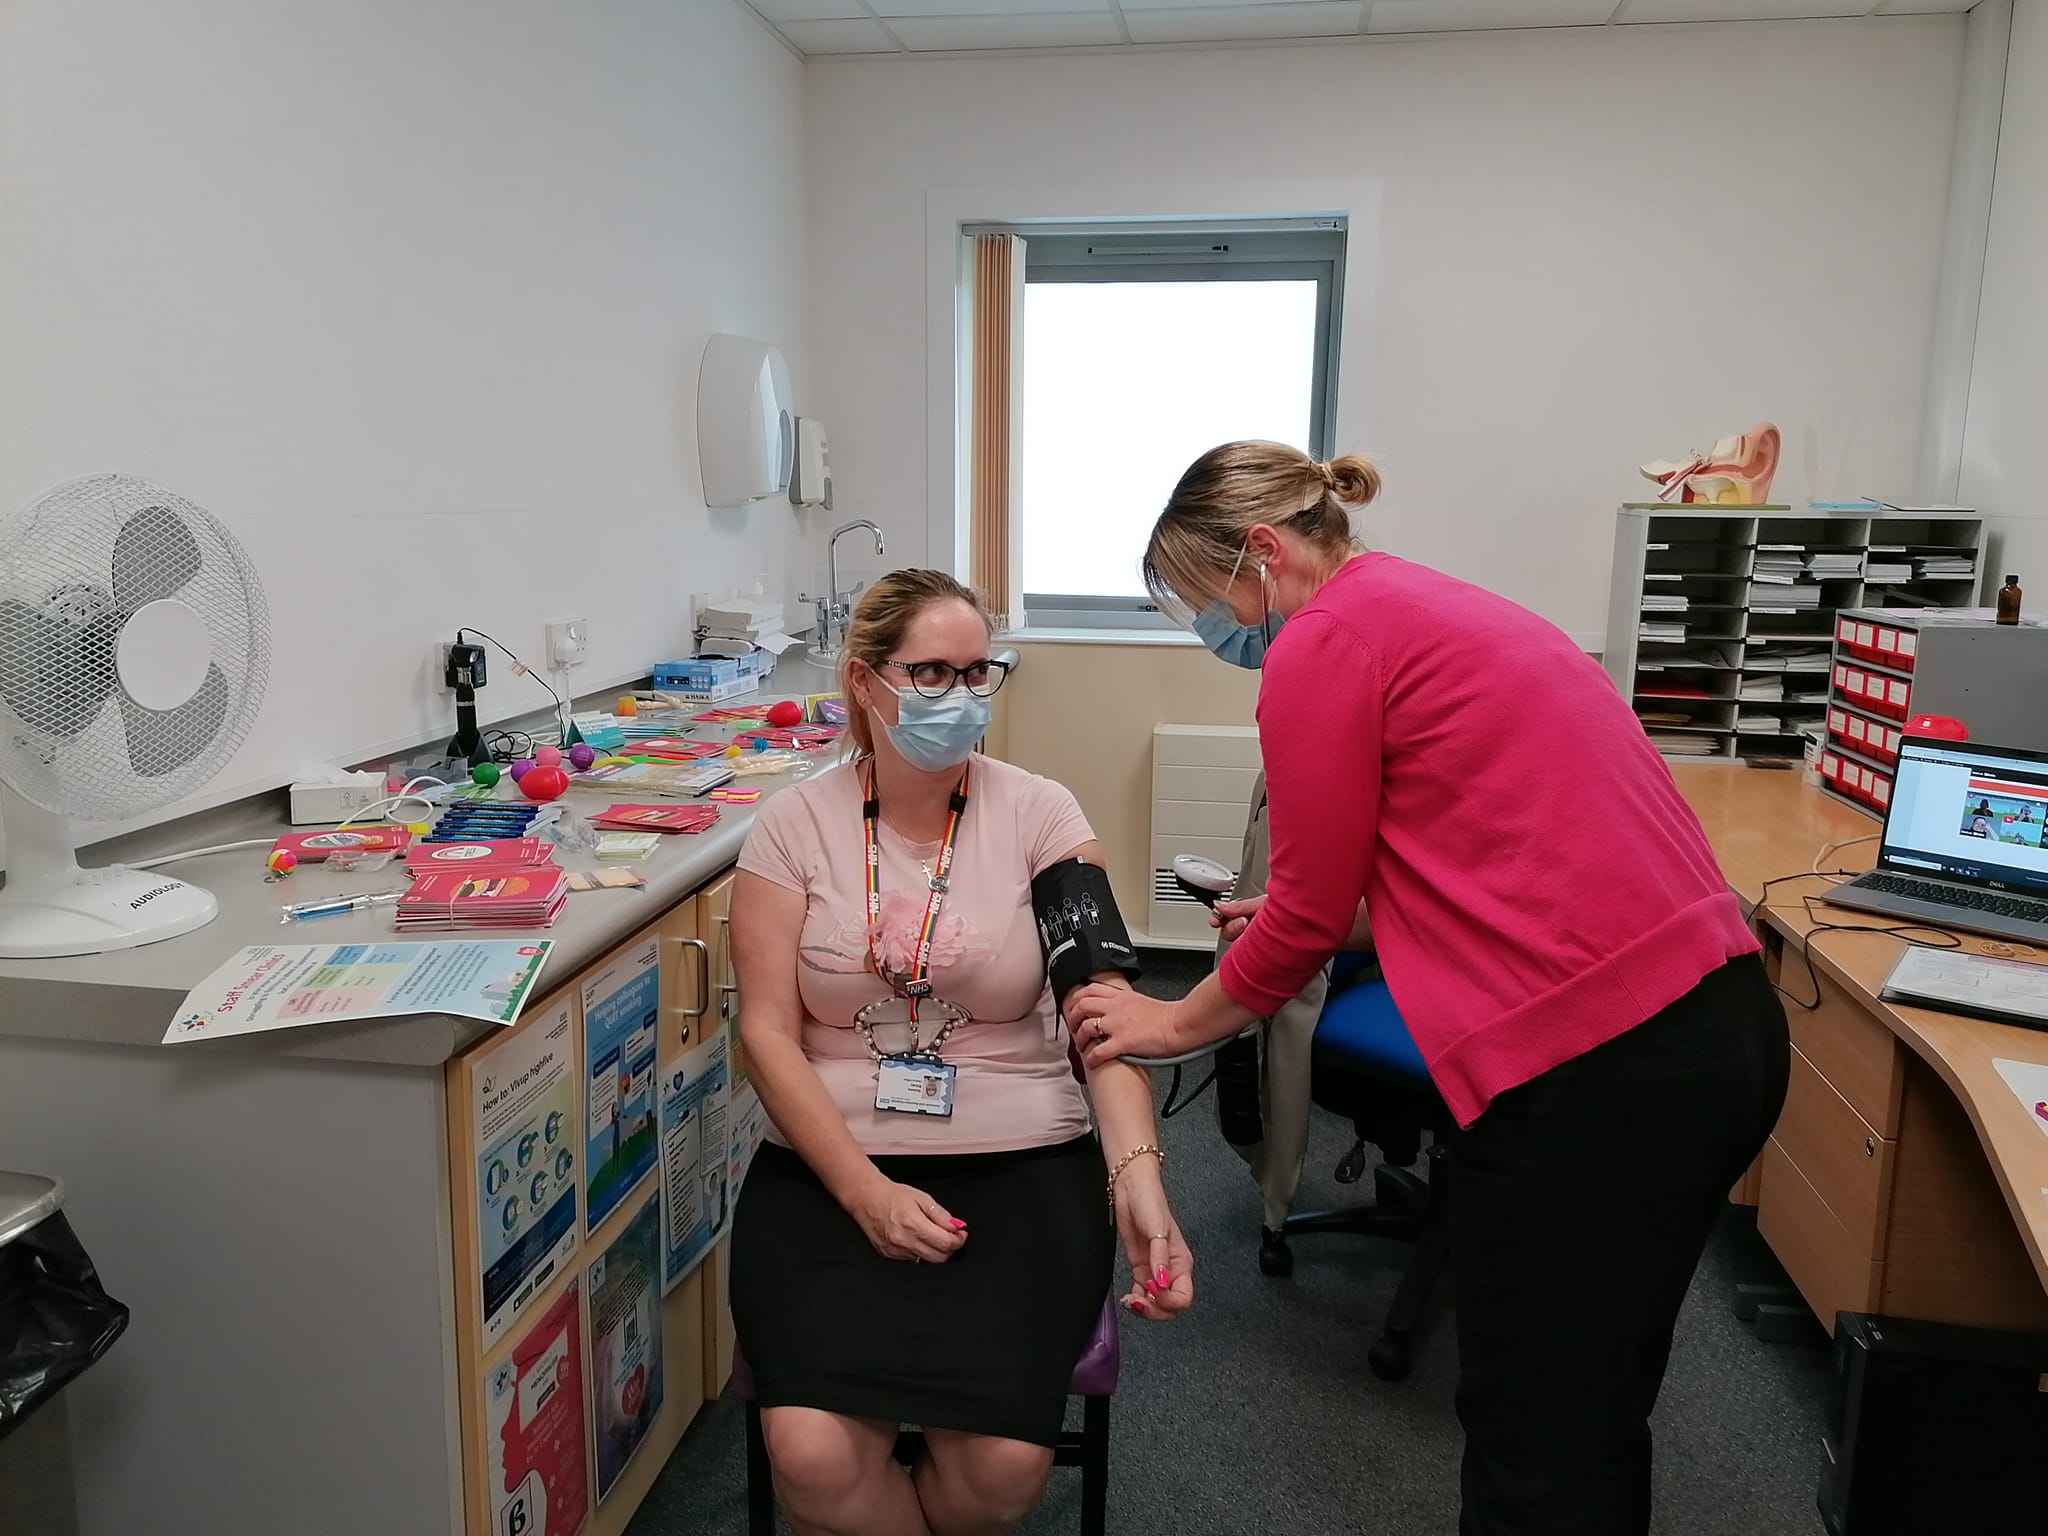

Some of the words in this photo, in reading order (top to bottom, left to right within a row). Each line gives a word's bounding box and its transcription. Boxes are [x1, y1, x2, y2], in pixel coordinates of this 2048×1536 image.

[867, 844, 879, 865] NHS
[940, 845, 953, 868] NHS
[130, 882, 185, 910] AUDIOLOGY
[1990, 880, 2005, 889] DELL
[868, 892, 880, 914] NHS
[928, 892, 942, 914] NHS
[917, 940, 930, 967] NHS
[217, 990, 243, 1012] Staff
[233, 972, 265, 989] Smear
[255, 953, 286, 972] Clinics
[910, 984, 929, 995] NHS
[594, 1001, 616, 1023] Helping
[644, 976, 651, 986] to
[619, 995, 642, 1018] smoking
[482, 1095, 500, 1114] How
[500, 1087, 510, 1100] to:
[510, 1072, 529, 1092] Vivup
[529, 1052, 553, 1078] highfive
